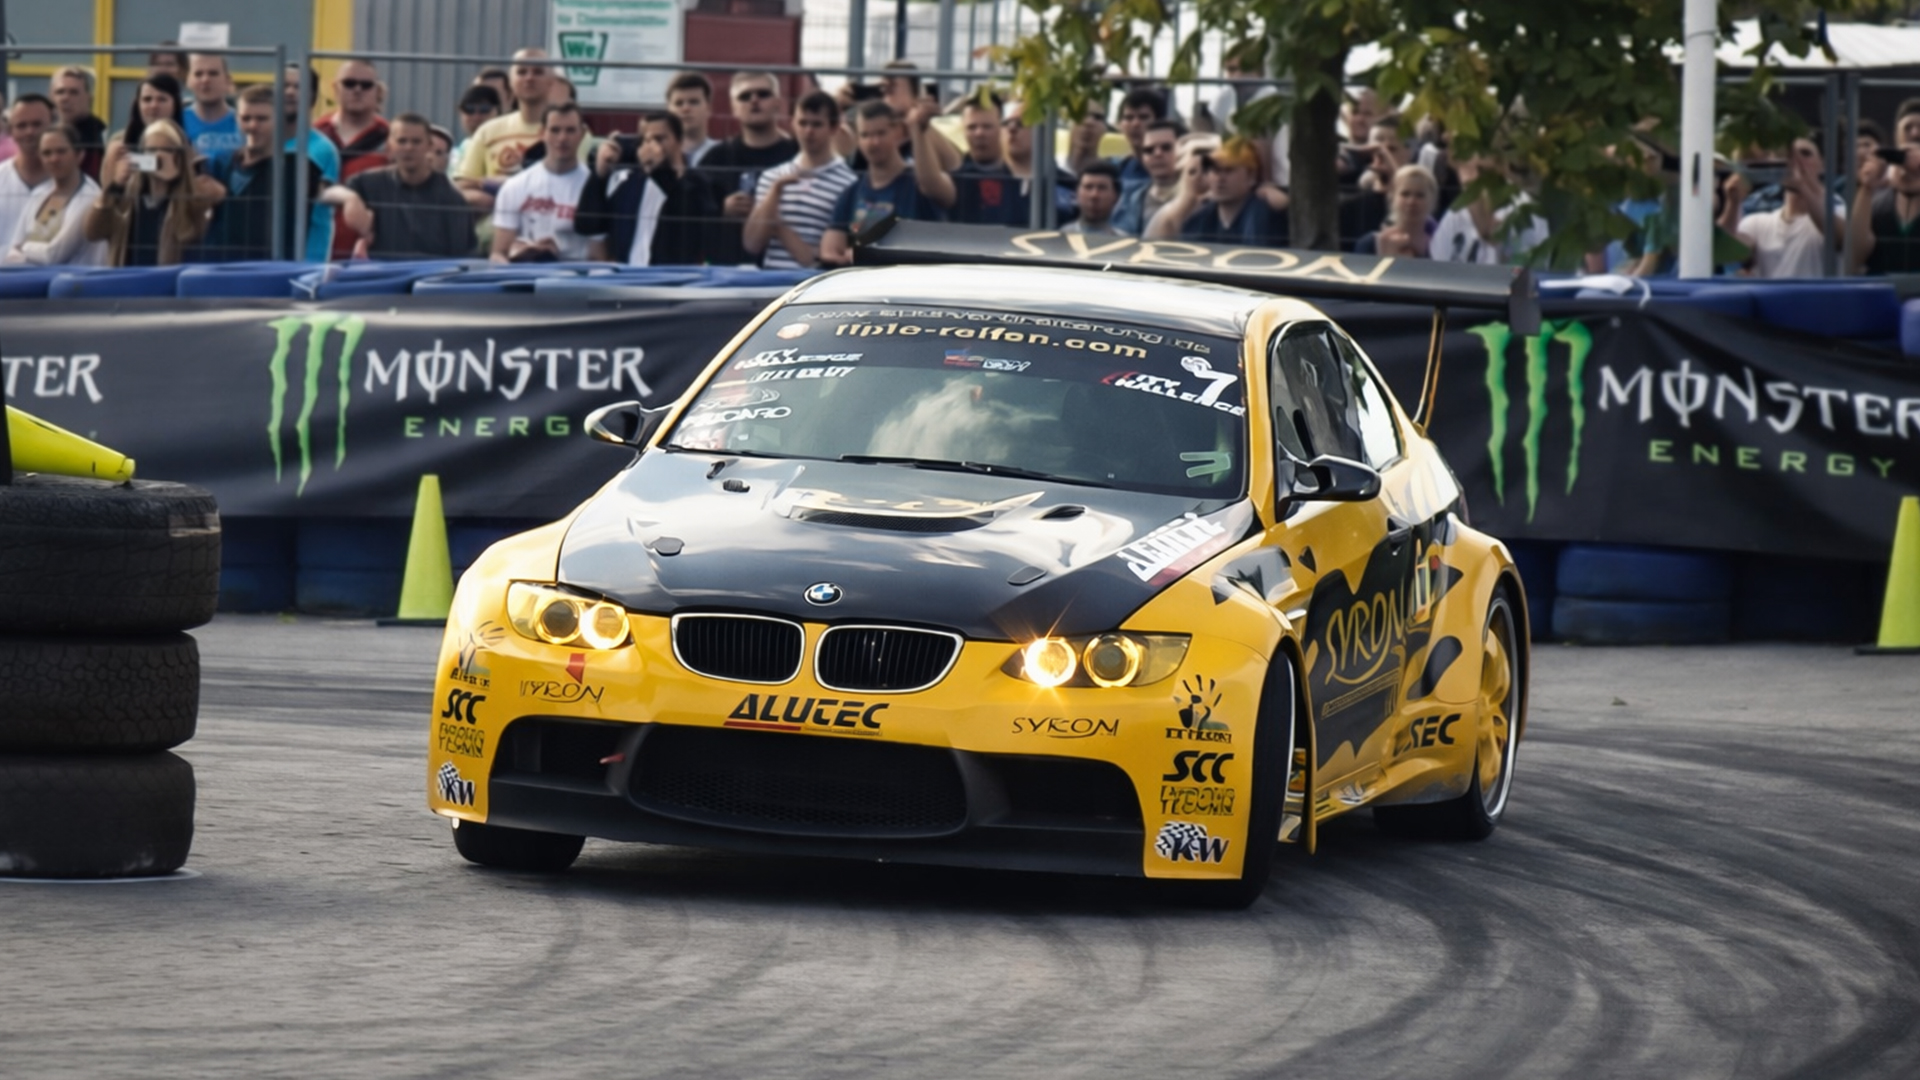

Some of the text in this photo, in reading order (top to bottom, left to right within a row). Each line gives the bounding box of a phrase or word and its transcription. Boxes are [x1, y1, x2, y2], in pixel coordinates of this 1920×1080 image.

[1004, 231, 1395, 285] SYRON
[404, 416, 571, 438] ENERG
[1649, 440, 1896, 479] ENERGY
[441, 687, 487, 725] SCC
[728, 693, 890, 729] ALUTEC
[1162, 750, 1235, 784] SCC
[1170, 834, 1231, 864] KW
